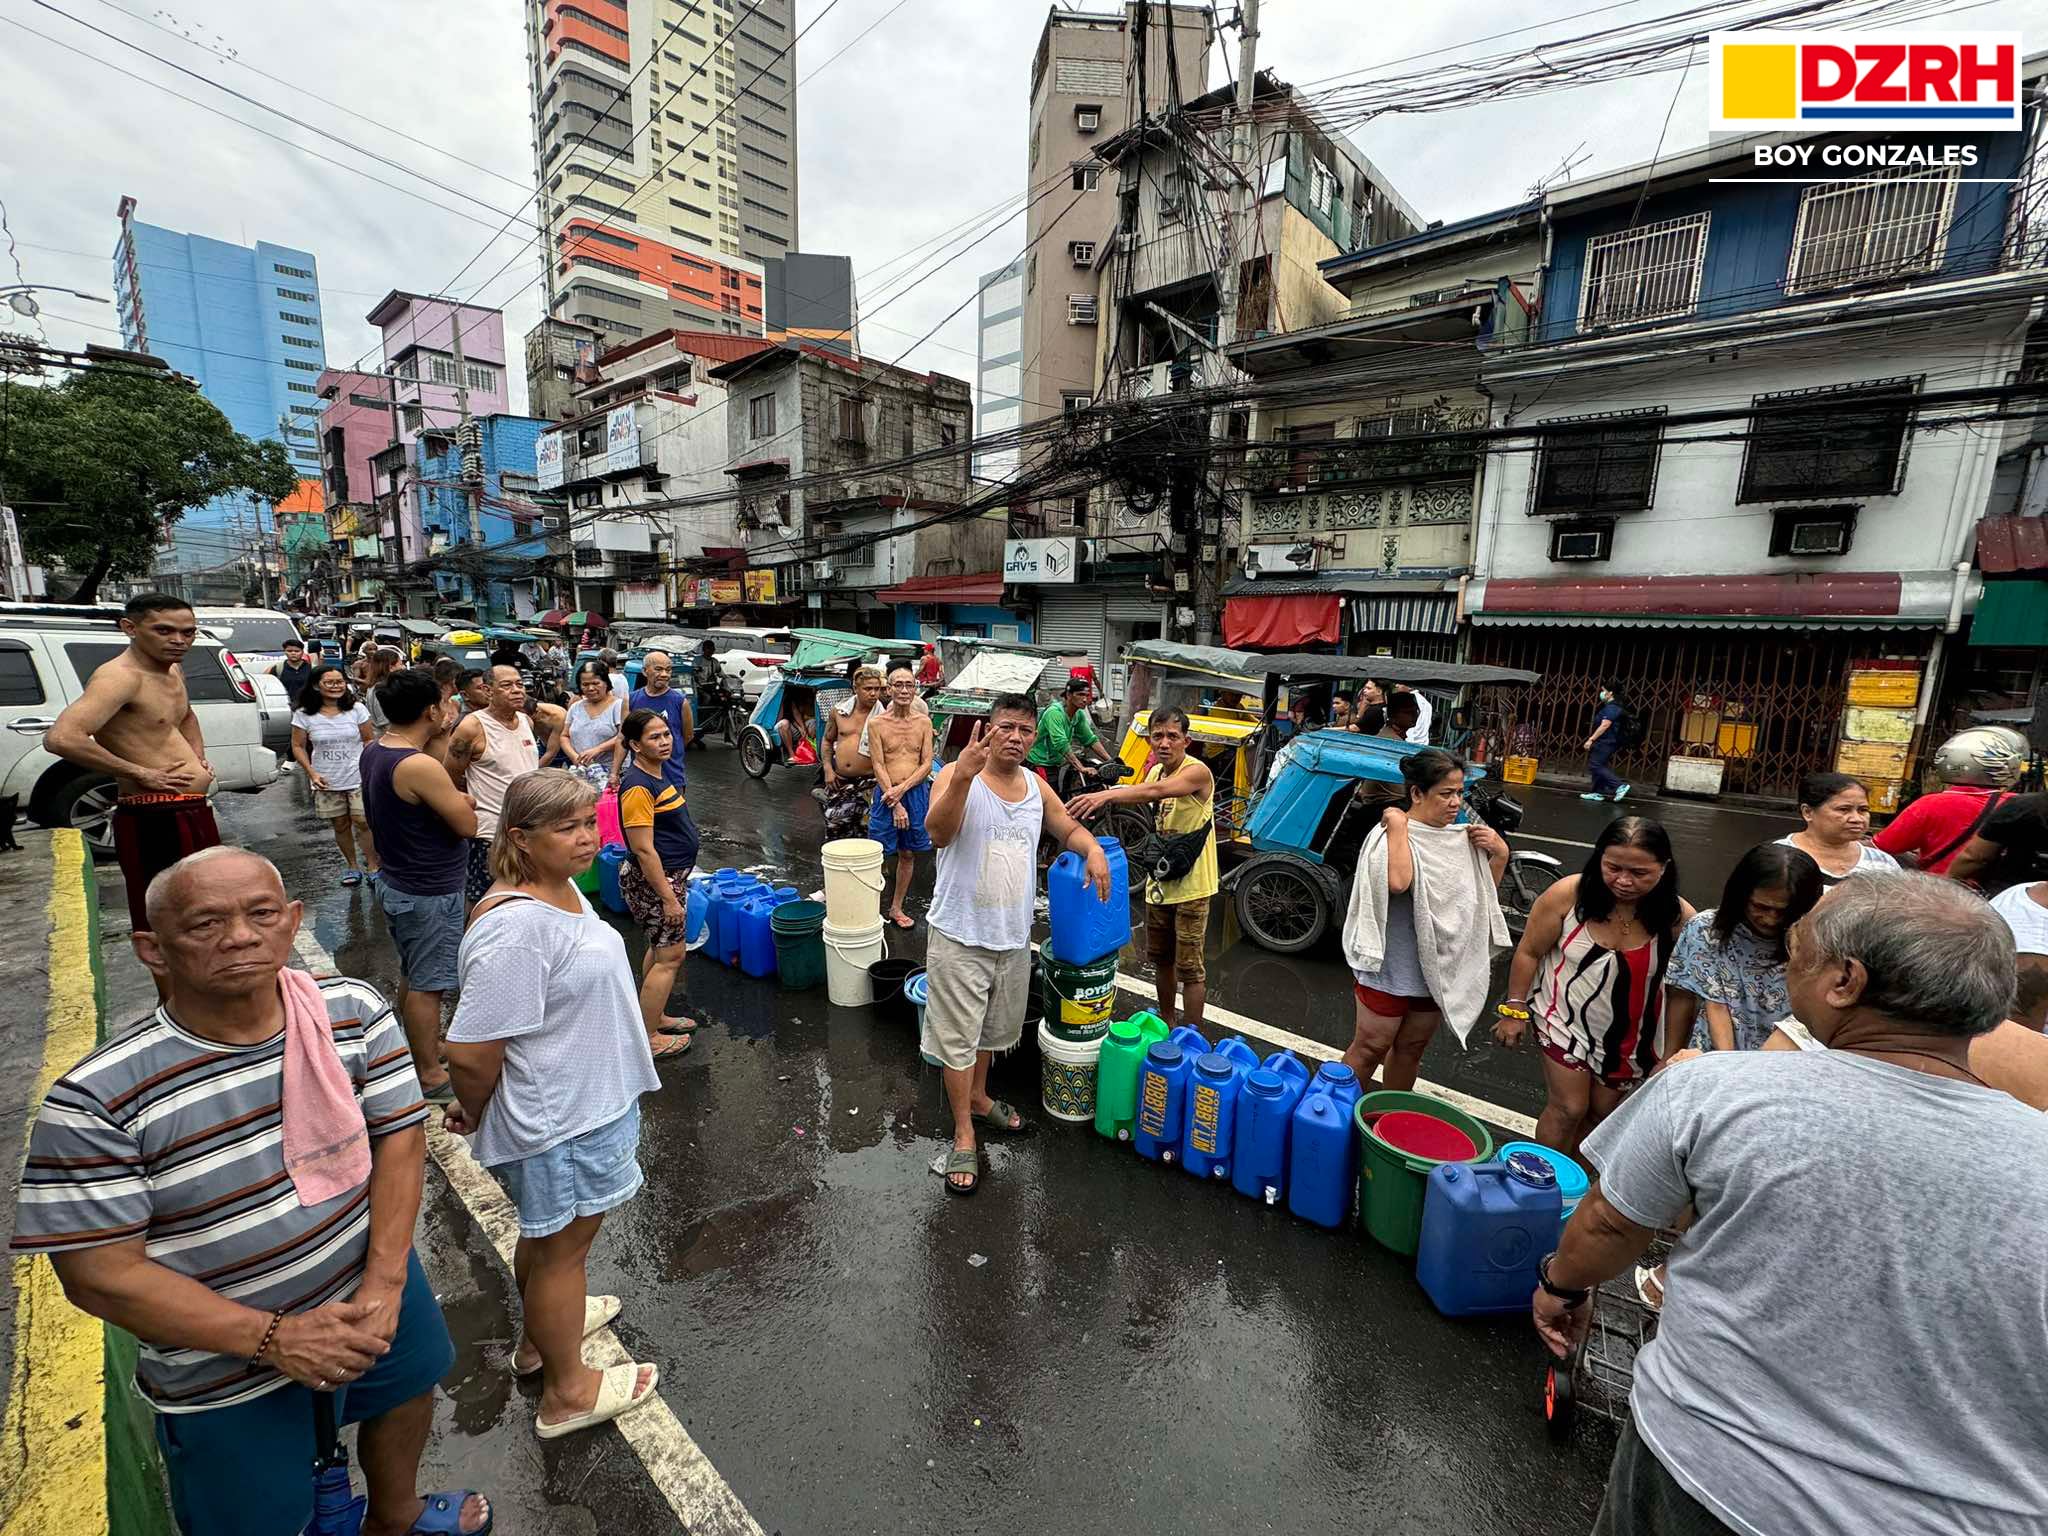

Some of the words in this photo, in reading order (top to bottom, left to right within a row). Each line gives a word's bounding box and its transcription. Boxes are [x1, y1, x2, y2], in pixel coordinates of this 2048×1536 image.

[613, 412, 631, 427] JUAN
[1006, 561, 1037, 572] GAV'S
[322, 750, 351, 761] RISK
[1076, 979, 1115, 996] BOYSE
[1145, 1072, 1167, 1116] BOBBY
[1196, 1084, 1216, 1129] BOBBY
[1192, 1127, 1212, 1153] LIM
